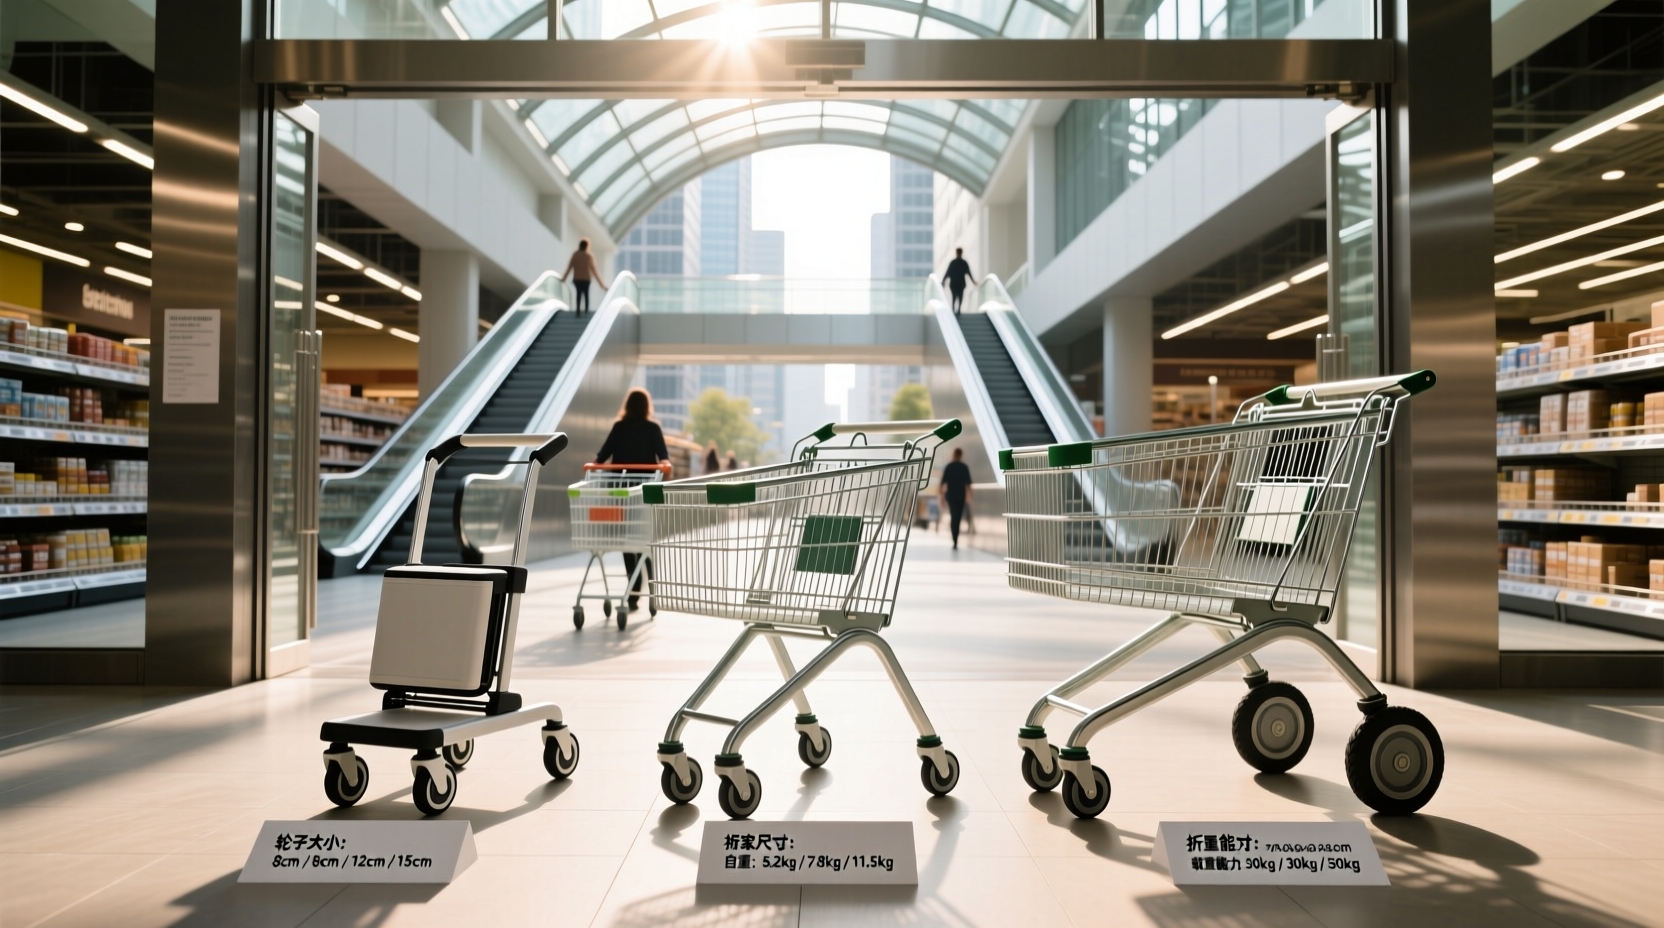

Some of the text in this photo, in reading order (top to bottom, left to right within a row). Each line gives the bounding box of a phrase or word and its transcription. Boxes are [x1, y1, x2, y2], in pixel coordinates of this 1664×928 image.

[274, 833, 347, 851] 轮子大小:
[272, 854, 300, 868] 8cm
[312, 854, 340, 868] 8cm
[351, 854, 386, 868] 12cm
[397, 854, 433, 868] 15cm
[852, 855, 894, 872] 11.5kg
[1286, 856, 1318, 873] 30kg
[1327, 857, 1361, 874] 50kg
